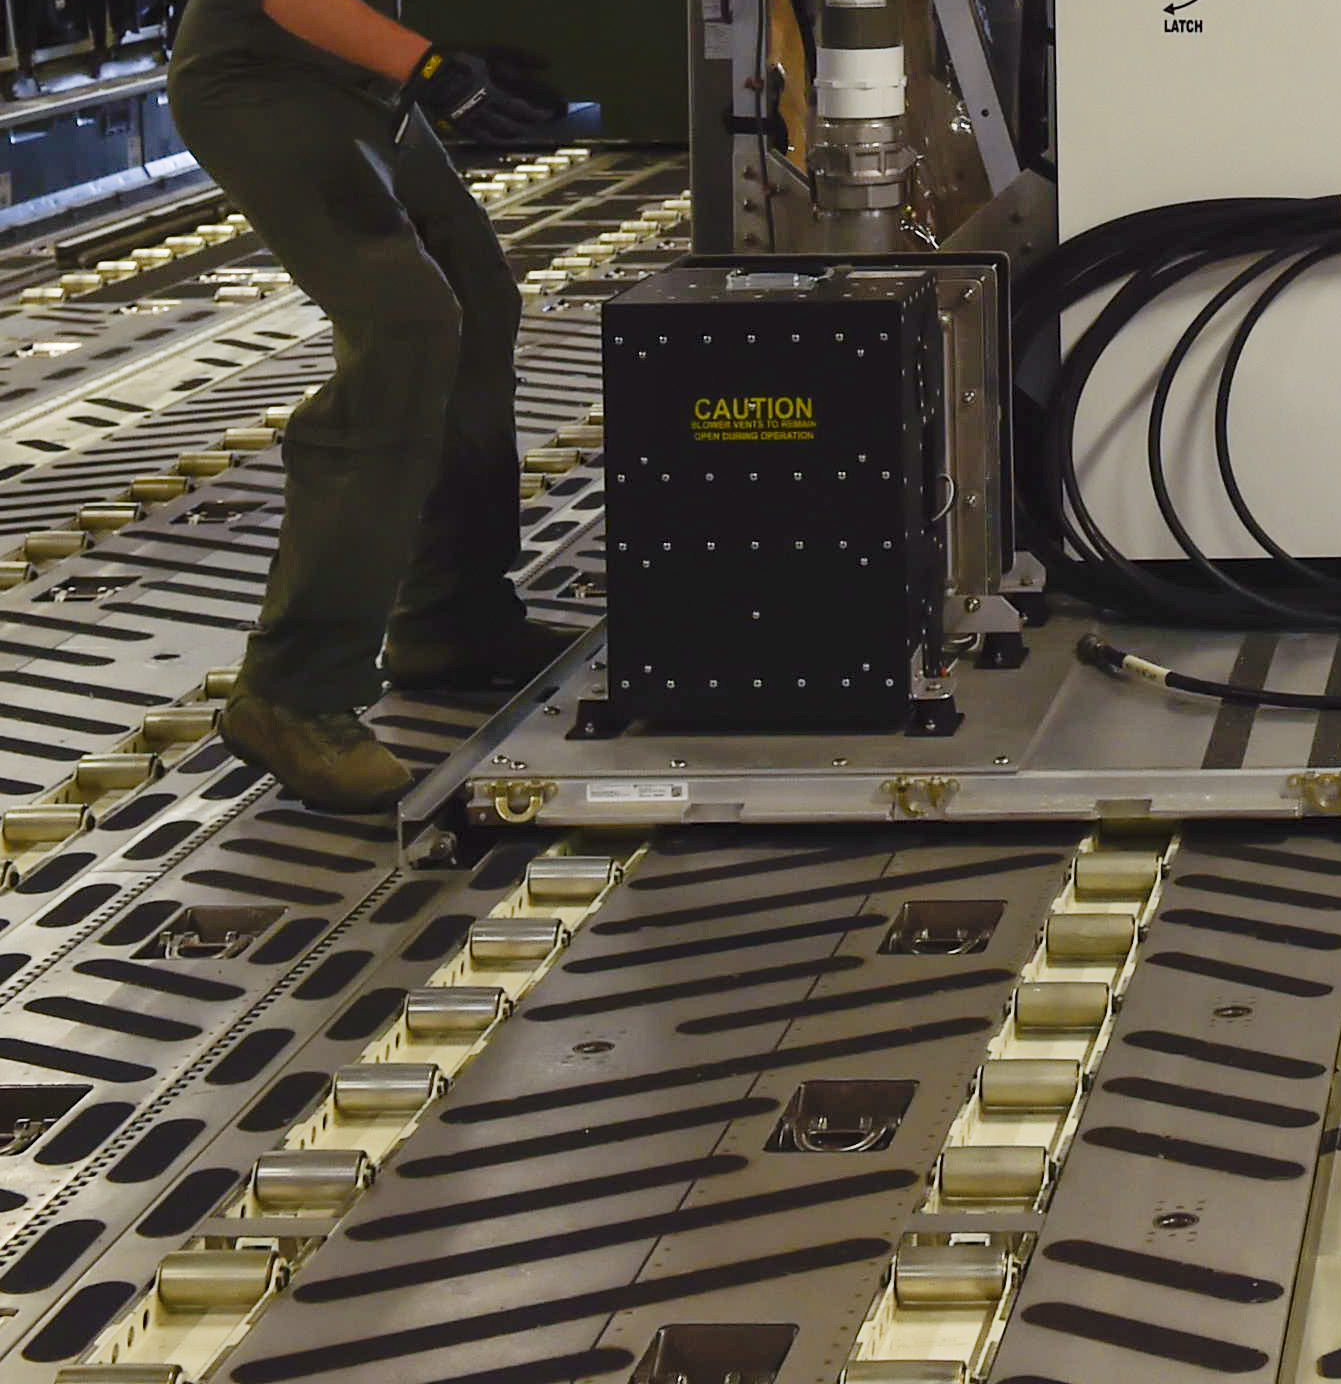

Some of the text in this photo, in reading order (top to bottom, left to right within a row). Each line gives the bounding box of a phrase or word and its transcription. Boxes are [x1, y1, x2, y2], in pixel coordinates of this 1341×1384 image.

[1164, 20, 1203, 33] LATCH
[695, 397, 812, 420] CAUTION
[733, 420, 763, 429] VENTS
[767, 420, 779, 428] TO
[694, 432, 720, 441] OPEN
[760, 431, 815, 440] OPERATION
